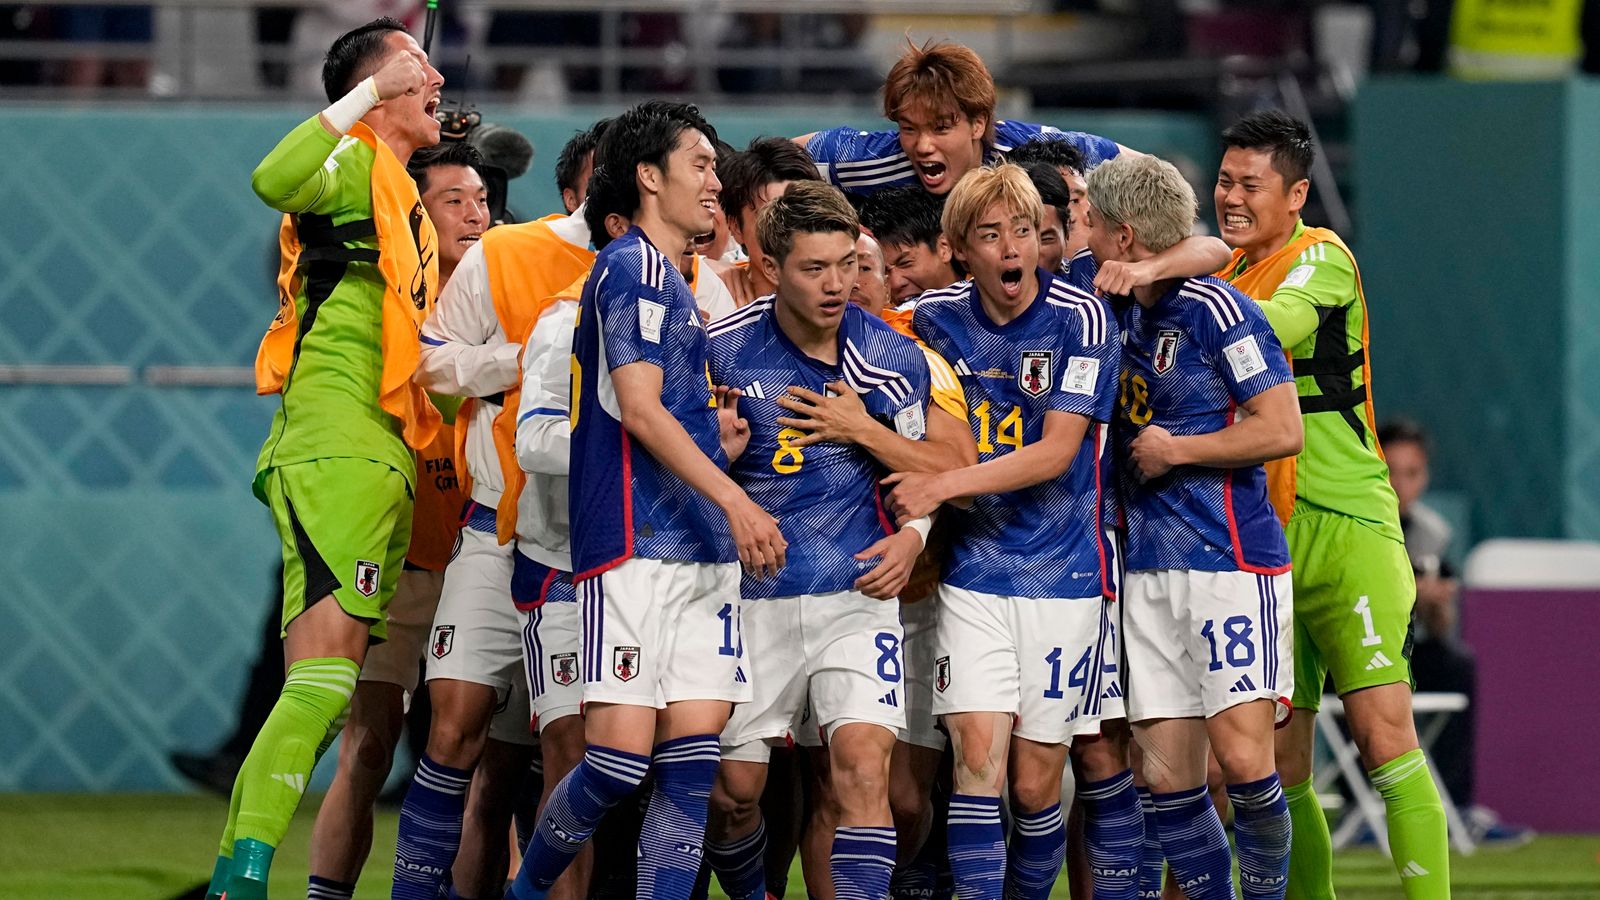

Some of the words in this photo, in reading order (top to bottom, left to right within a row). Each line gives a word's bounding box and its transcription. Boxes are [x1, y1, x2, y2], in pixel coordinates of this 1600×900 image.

[772, 428, 806, 474] 8
[973, 399, 1024, 453] 14
[425, 457, 454, 474] FIA
[1201, 615, 1256, 672] 18
[1353, 595, 1382, 647] 1
[874, 632, 901, 683] 8
[1043, 645, 1092, 699] 14
